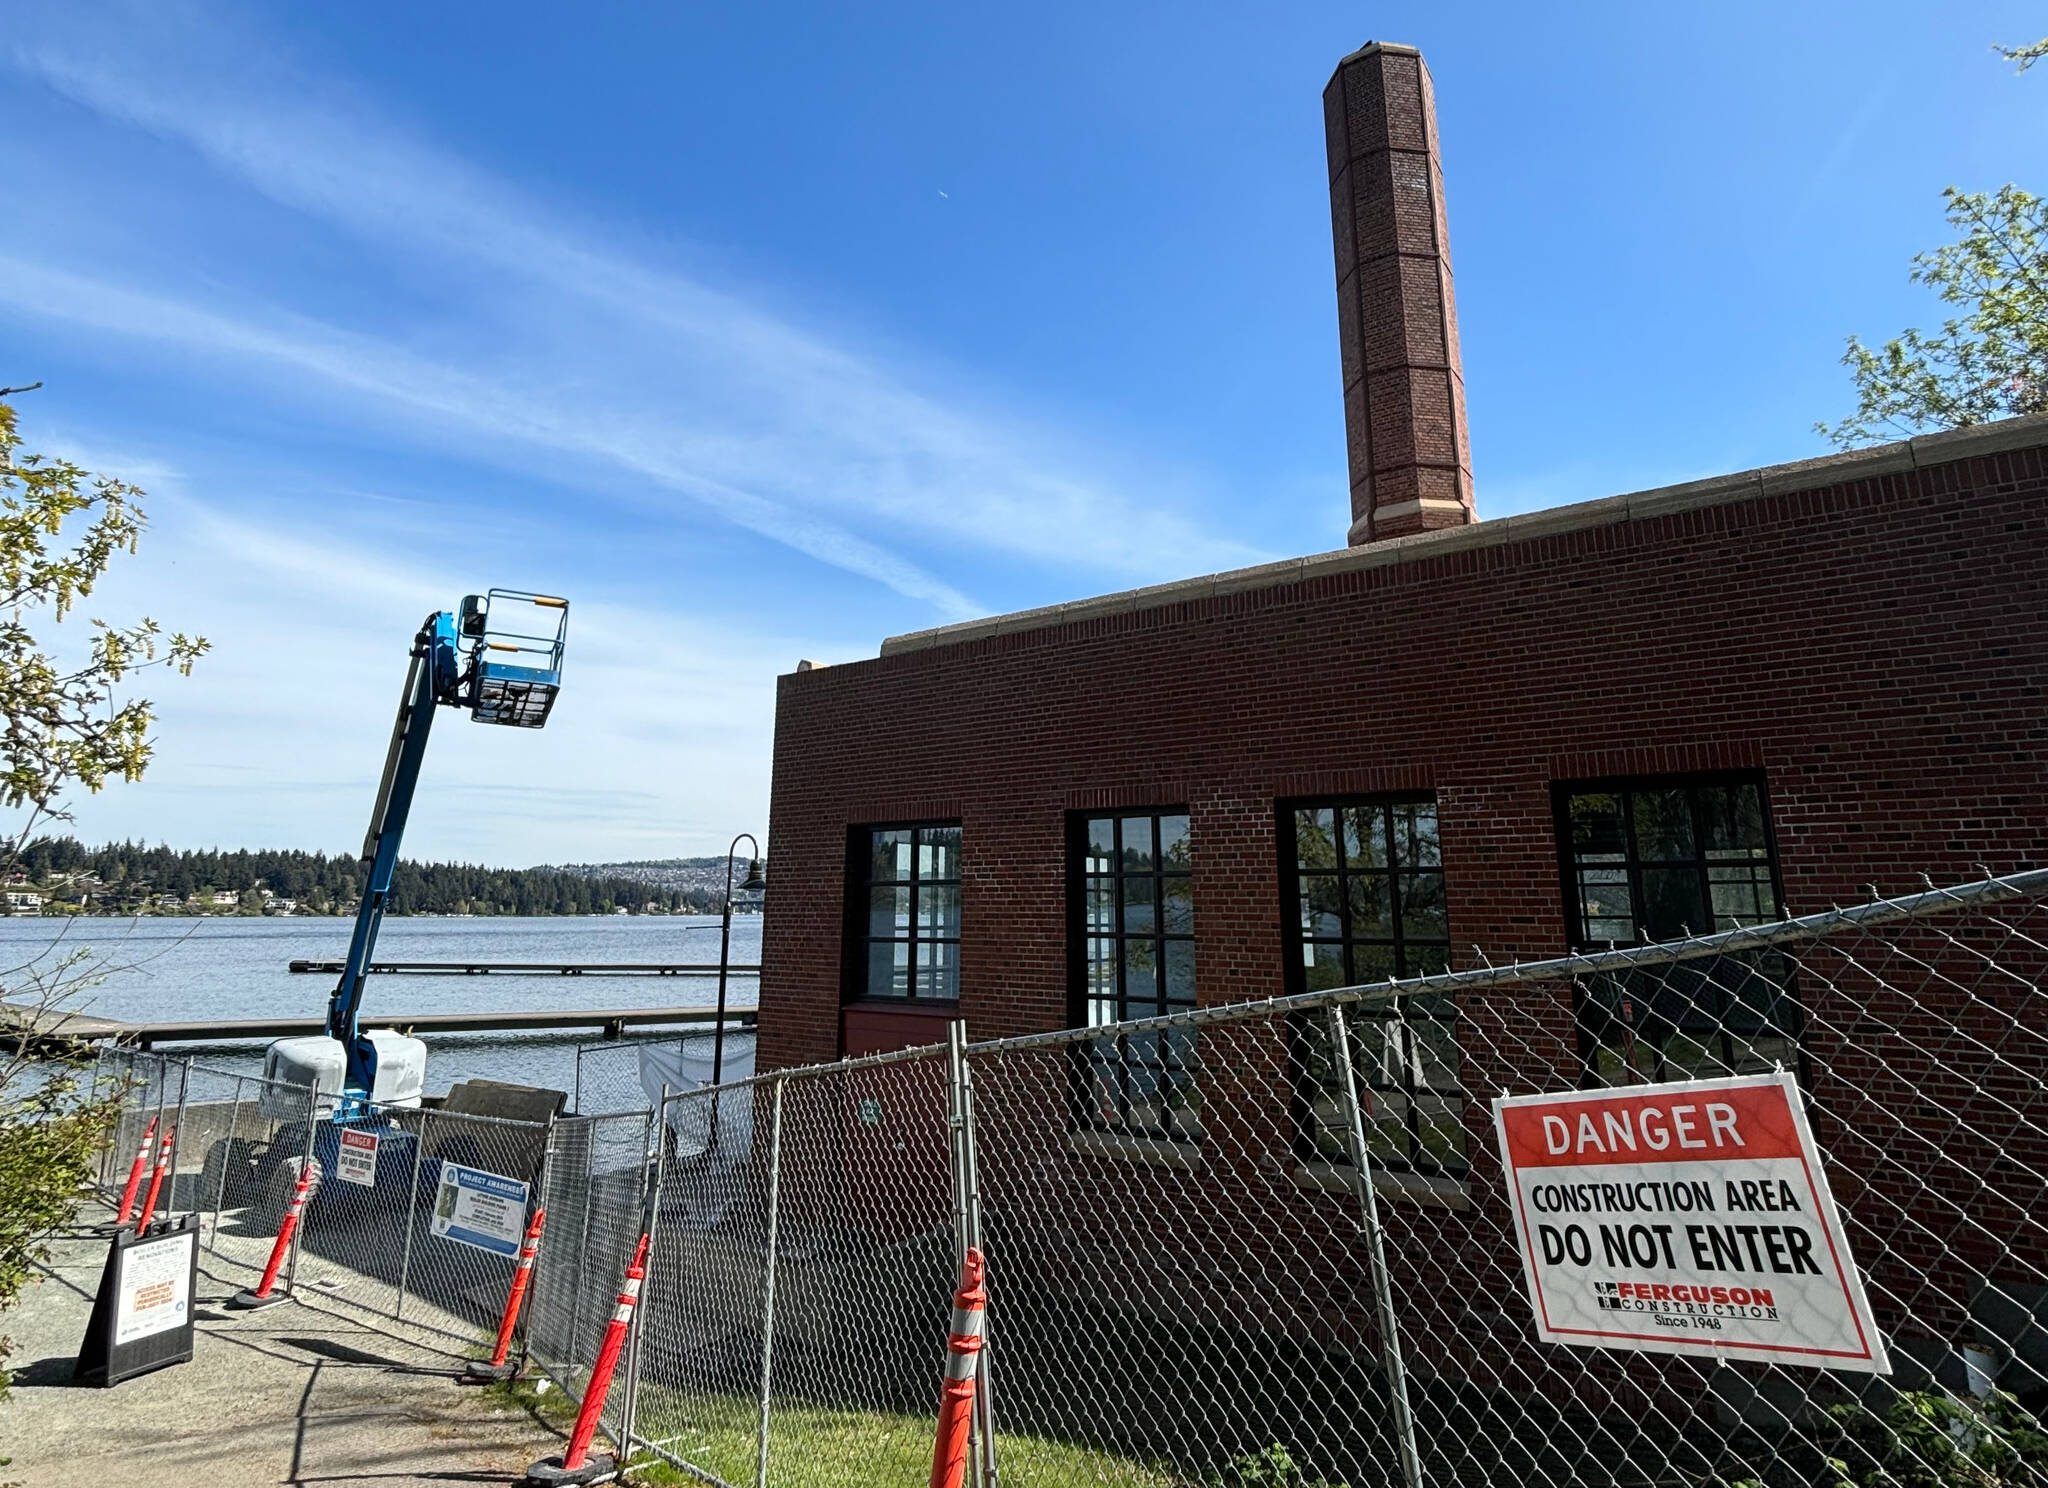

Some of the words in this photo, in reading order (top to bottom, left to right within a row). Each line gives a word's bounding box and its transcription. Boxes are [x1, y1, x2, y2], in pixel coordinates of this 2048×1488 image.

[347, 1134, 371, 1147] DANGER
[1542, 1103, 1746, 1155] DANGER
[460, 1172, 487, 1185] PROJECT
[486, 1180, 524, 1195] AWARENESS
[1532, 1181, 1716, 1213] CONSTRUCTION
[1725, 1179, 1802, 1212] AREA
[1538, 1224, 1592, 1267] DO
[1599, 1224, 1677, 1270] NOT
[1686, 1224, 1823, 1275] ENTER
[1617, 1282, 1775, 1307] FERGUSON
[1622, 1299, 1778, 1319] CONSTRUCTION
[1654, 1315, 1688, 1328] Since
[1692, 1317, 1722, 1330] 1948
